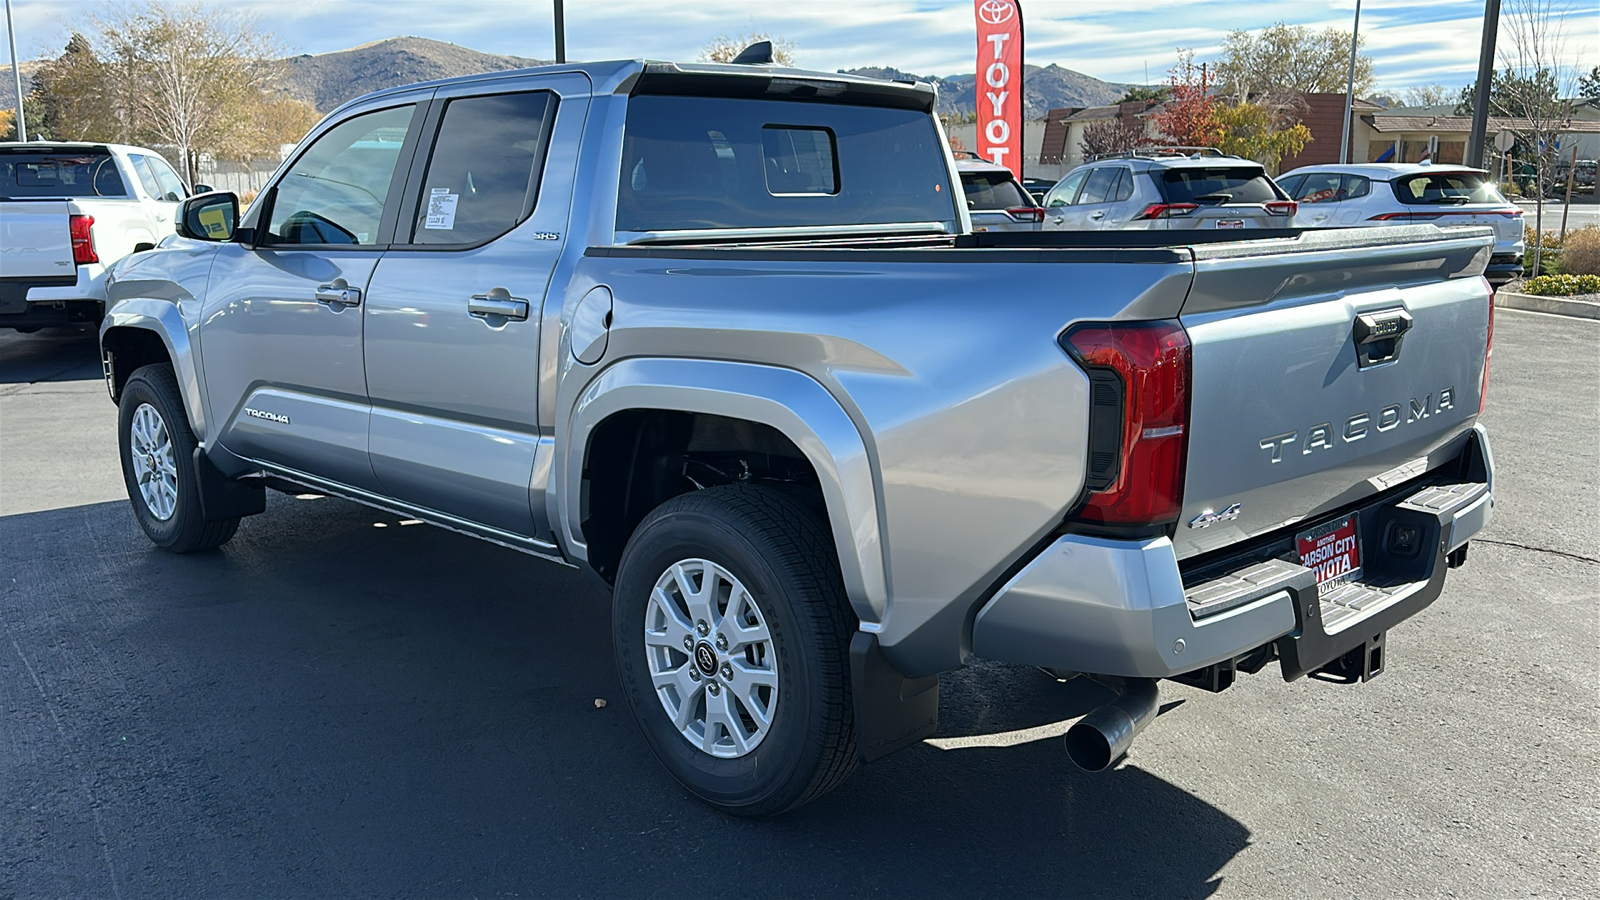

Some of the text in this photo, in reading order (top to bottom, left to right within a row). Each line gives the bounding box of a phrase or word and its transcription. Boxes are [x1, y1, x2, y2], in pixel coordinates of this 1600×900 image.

[985, 33, 1010, 167] TOYOT
[245, 407, 290, 424] TACOMA
[1259, 386, 1455, 464] TACOMA
[1316, 534, 1335, 548] ANOTHER
[1335, 534, 1356, 554] CITY
[1312, 553, 1351, 583] OYOTA
[1320, 576, 1346, 594] OYOTA
